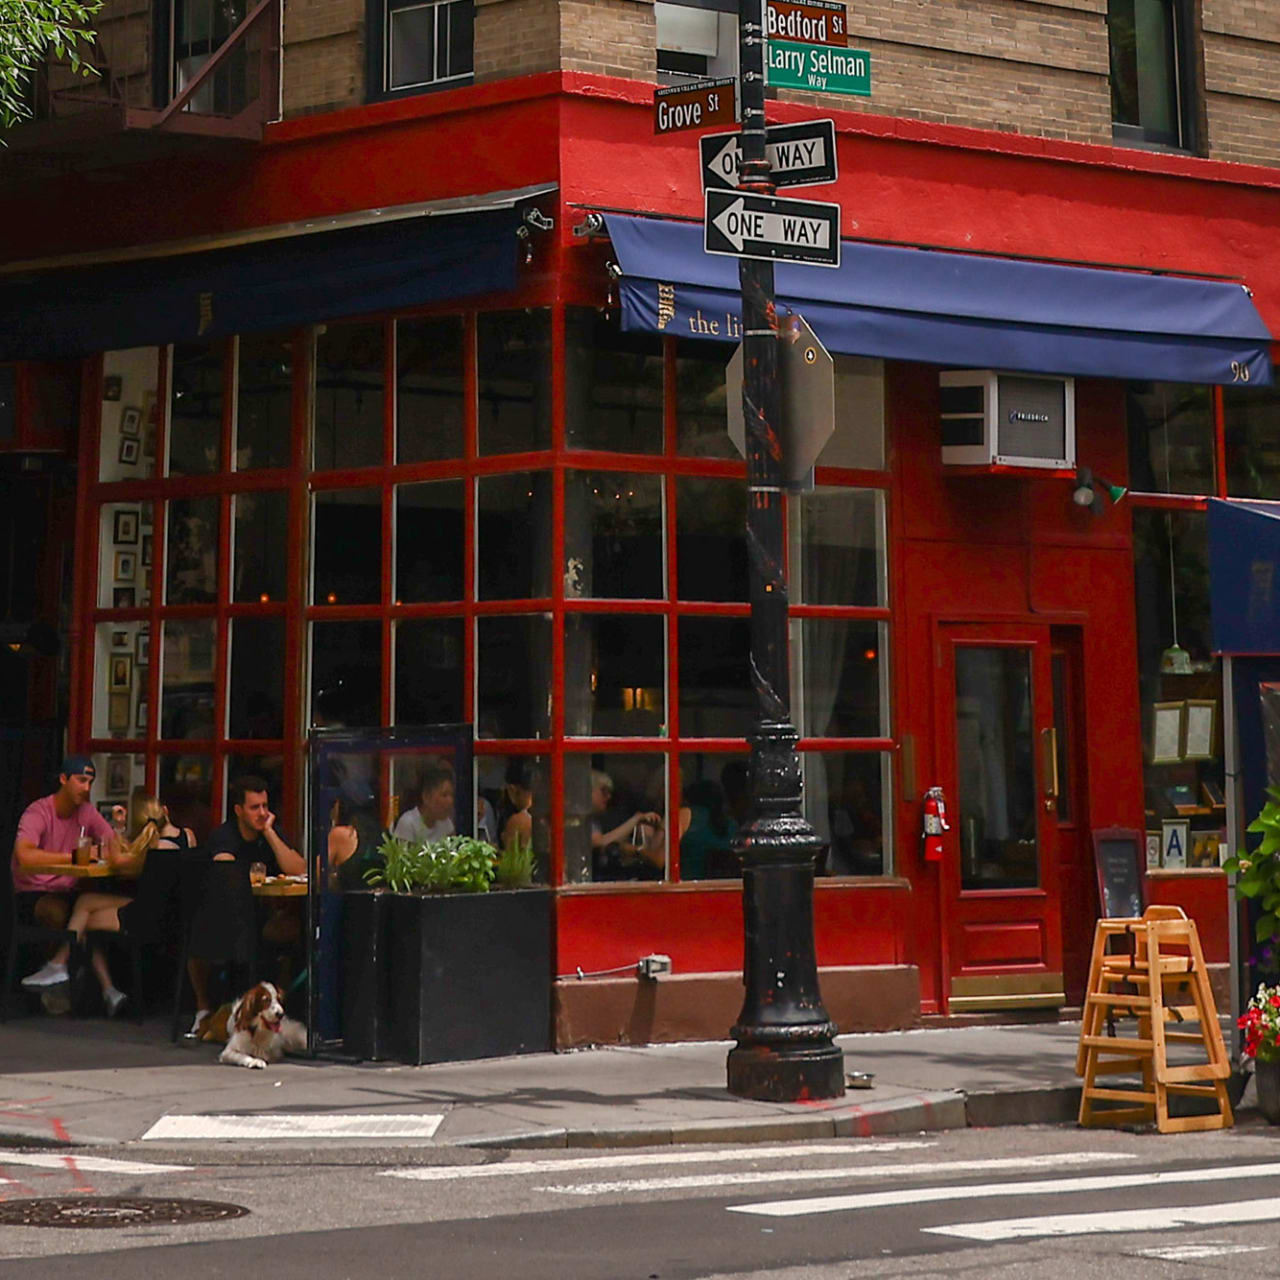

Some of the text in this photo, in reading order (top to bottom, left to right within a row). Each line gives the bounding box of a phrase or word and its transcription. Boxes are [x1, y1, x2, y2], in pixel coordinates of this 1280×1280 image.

[767, 6, 843, 42] Bedford St
[768, 44, 865, 77] Larry Selman
[807, 73, 828, 90] Way
[658, 93, 720, 130] Grove St
[776, 141, 816, 169] WAY
[727, 212, 822, 245] ONE WAY
[688, 309, 721, 336] the
[1230, 360, 1251, 383] 90
[1166, 829, 1183, 857] A
